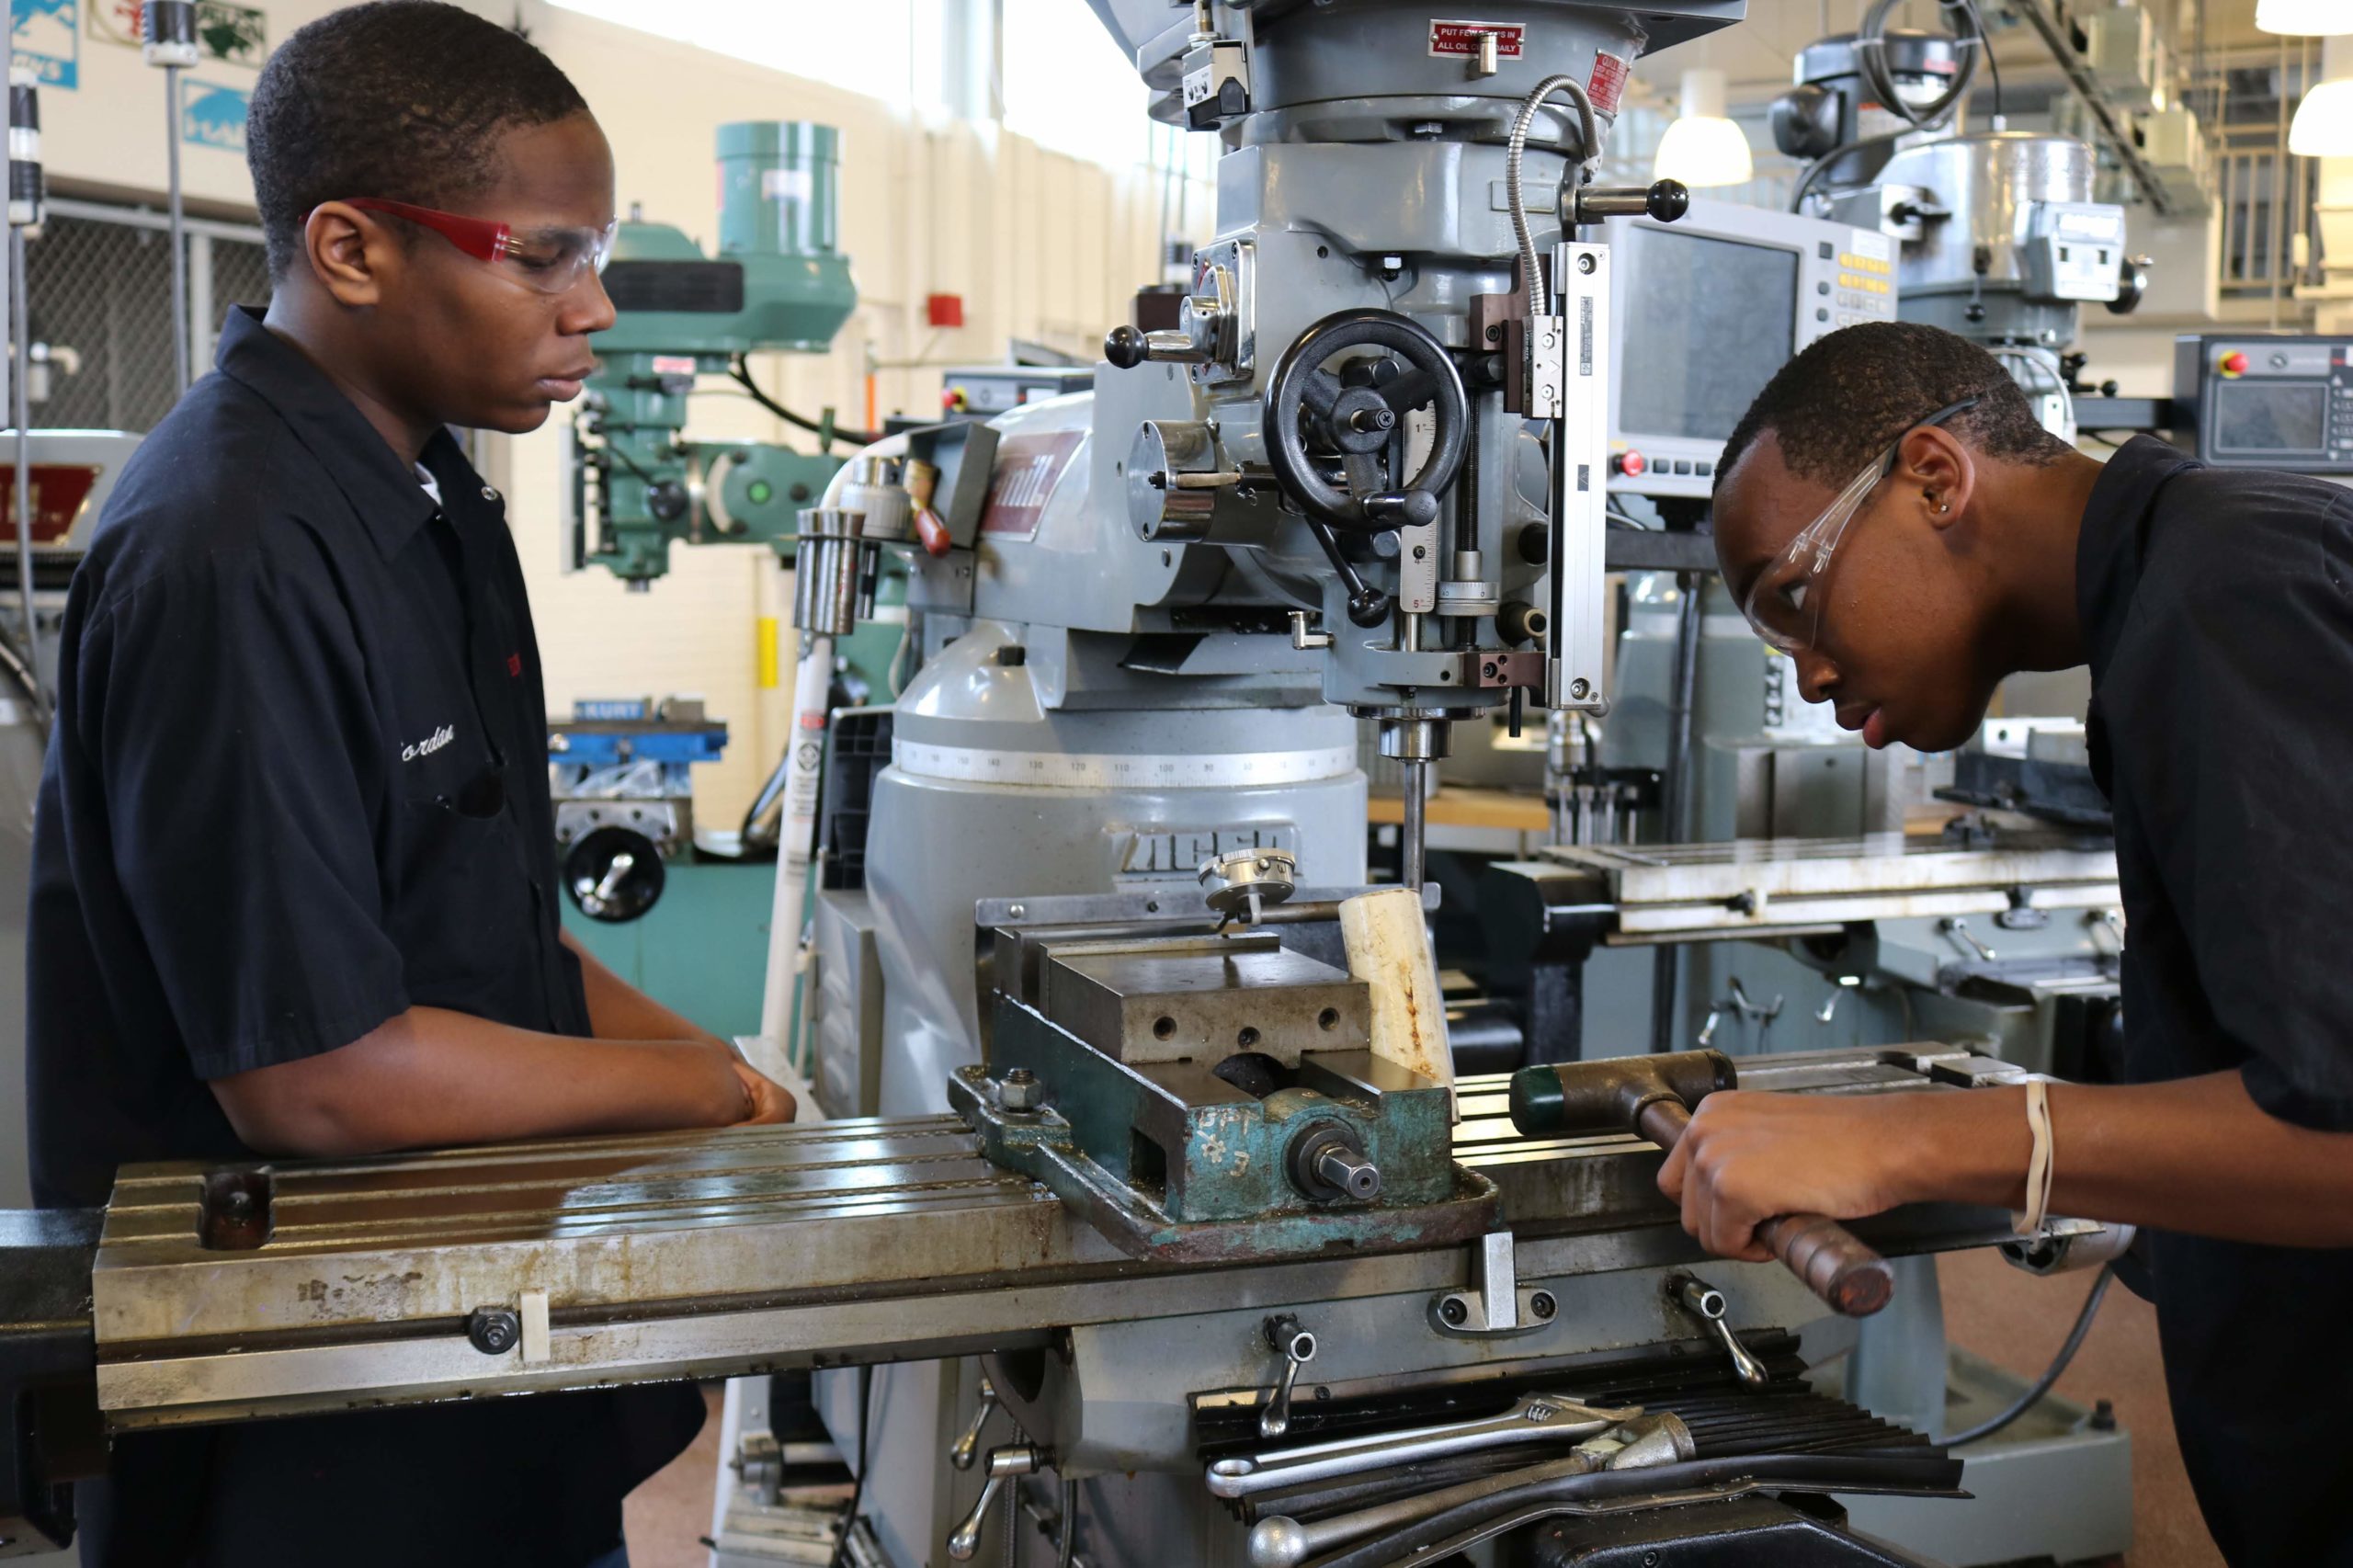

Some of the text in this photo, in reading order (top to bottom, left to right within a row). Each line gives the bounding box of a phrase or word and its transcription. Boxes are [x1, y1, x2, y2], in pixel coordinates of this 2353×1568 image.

[1459, 28, 1478, 37] FEW
[1456, 42, 1469, 51] OIL
[400, 724, 454, 762] ordan
[1029, 761, 1043, 769] 130
[1071, 762, 1086, 770] 120
[1114, 764, 1130, 772] 110
[1159, 764, 1175, 772] 100
